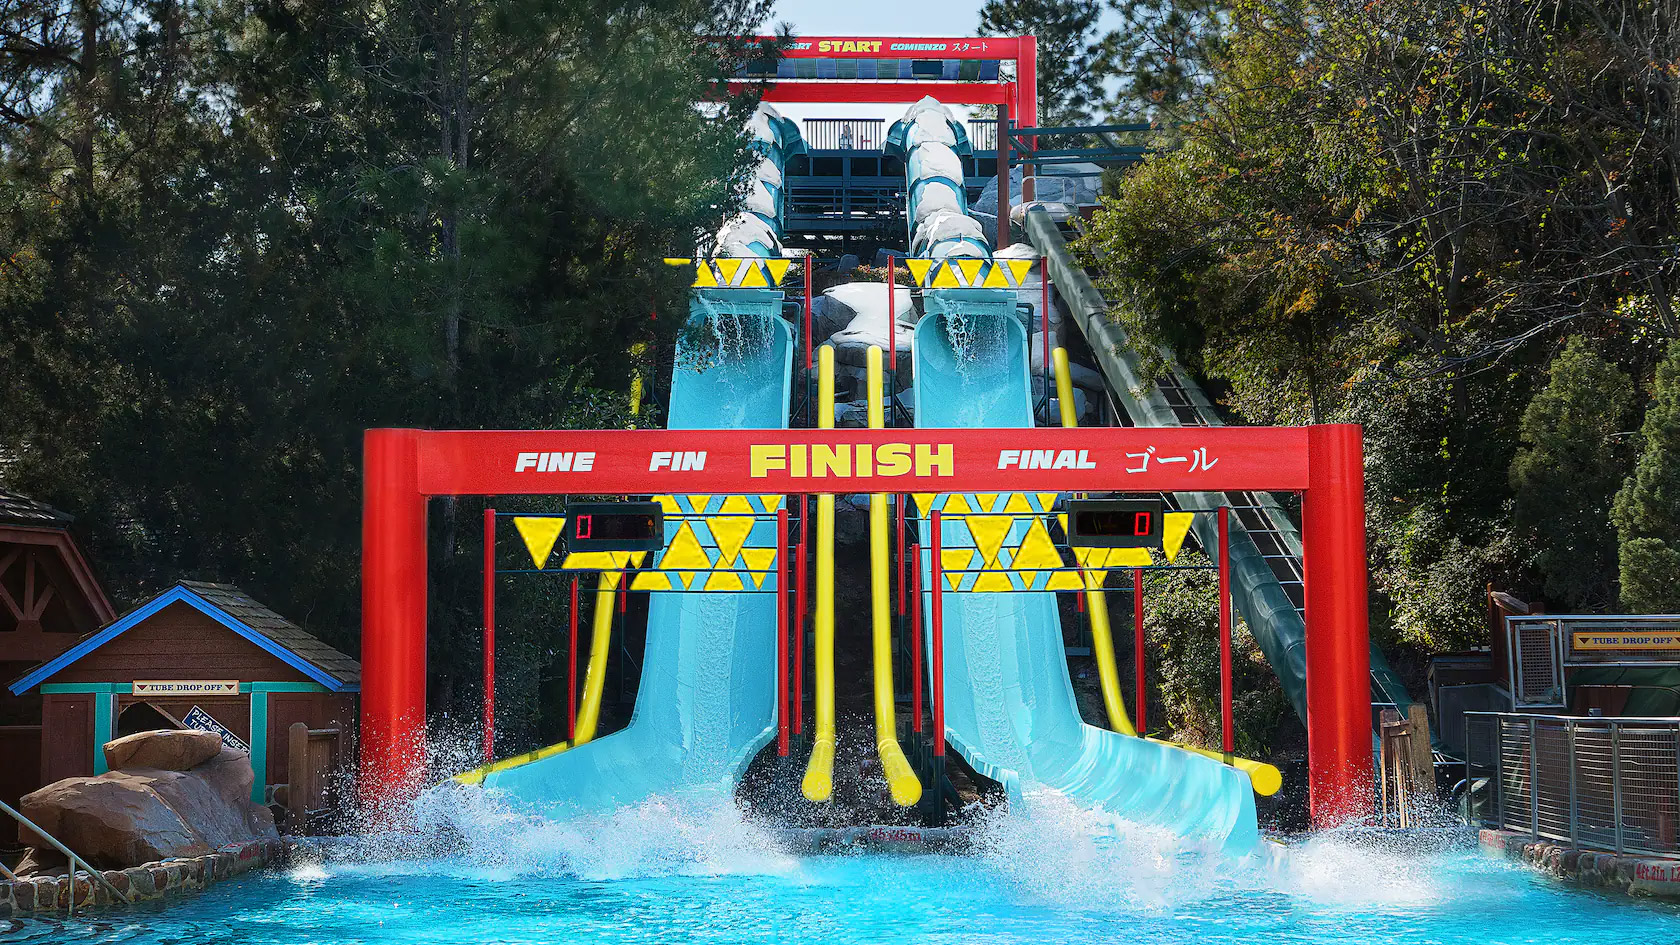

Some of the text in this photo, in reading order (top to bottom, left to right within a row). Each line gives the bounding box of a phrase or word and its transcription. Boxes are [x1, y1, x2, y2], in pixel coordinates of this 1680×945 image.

[818, 40, 883, 53] START
[890, 43, 947, 51] COMIENZO
[952, 42, 989, 52] スタート
[514, 452, 597, 472] FINE
[648, 451, 707, 471] FIN
[750, 443, 954, 477] FINISH
[997, 449, 1097, 470] FINAL
[1125, 445, 1219, 474] ゴール
[576, 515, 592, 539] 0
[1134, 511, 1150, 536] 0
[1592, 637, 1673, 645] TUBE DROP OFF
[149, 684, 223, 692] TUBE DROP OFF
[191, 709, 224, 735] PLEASE
